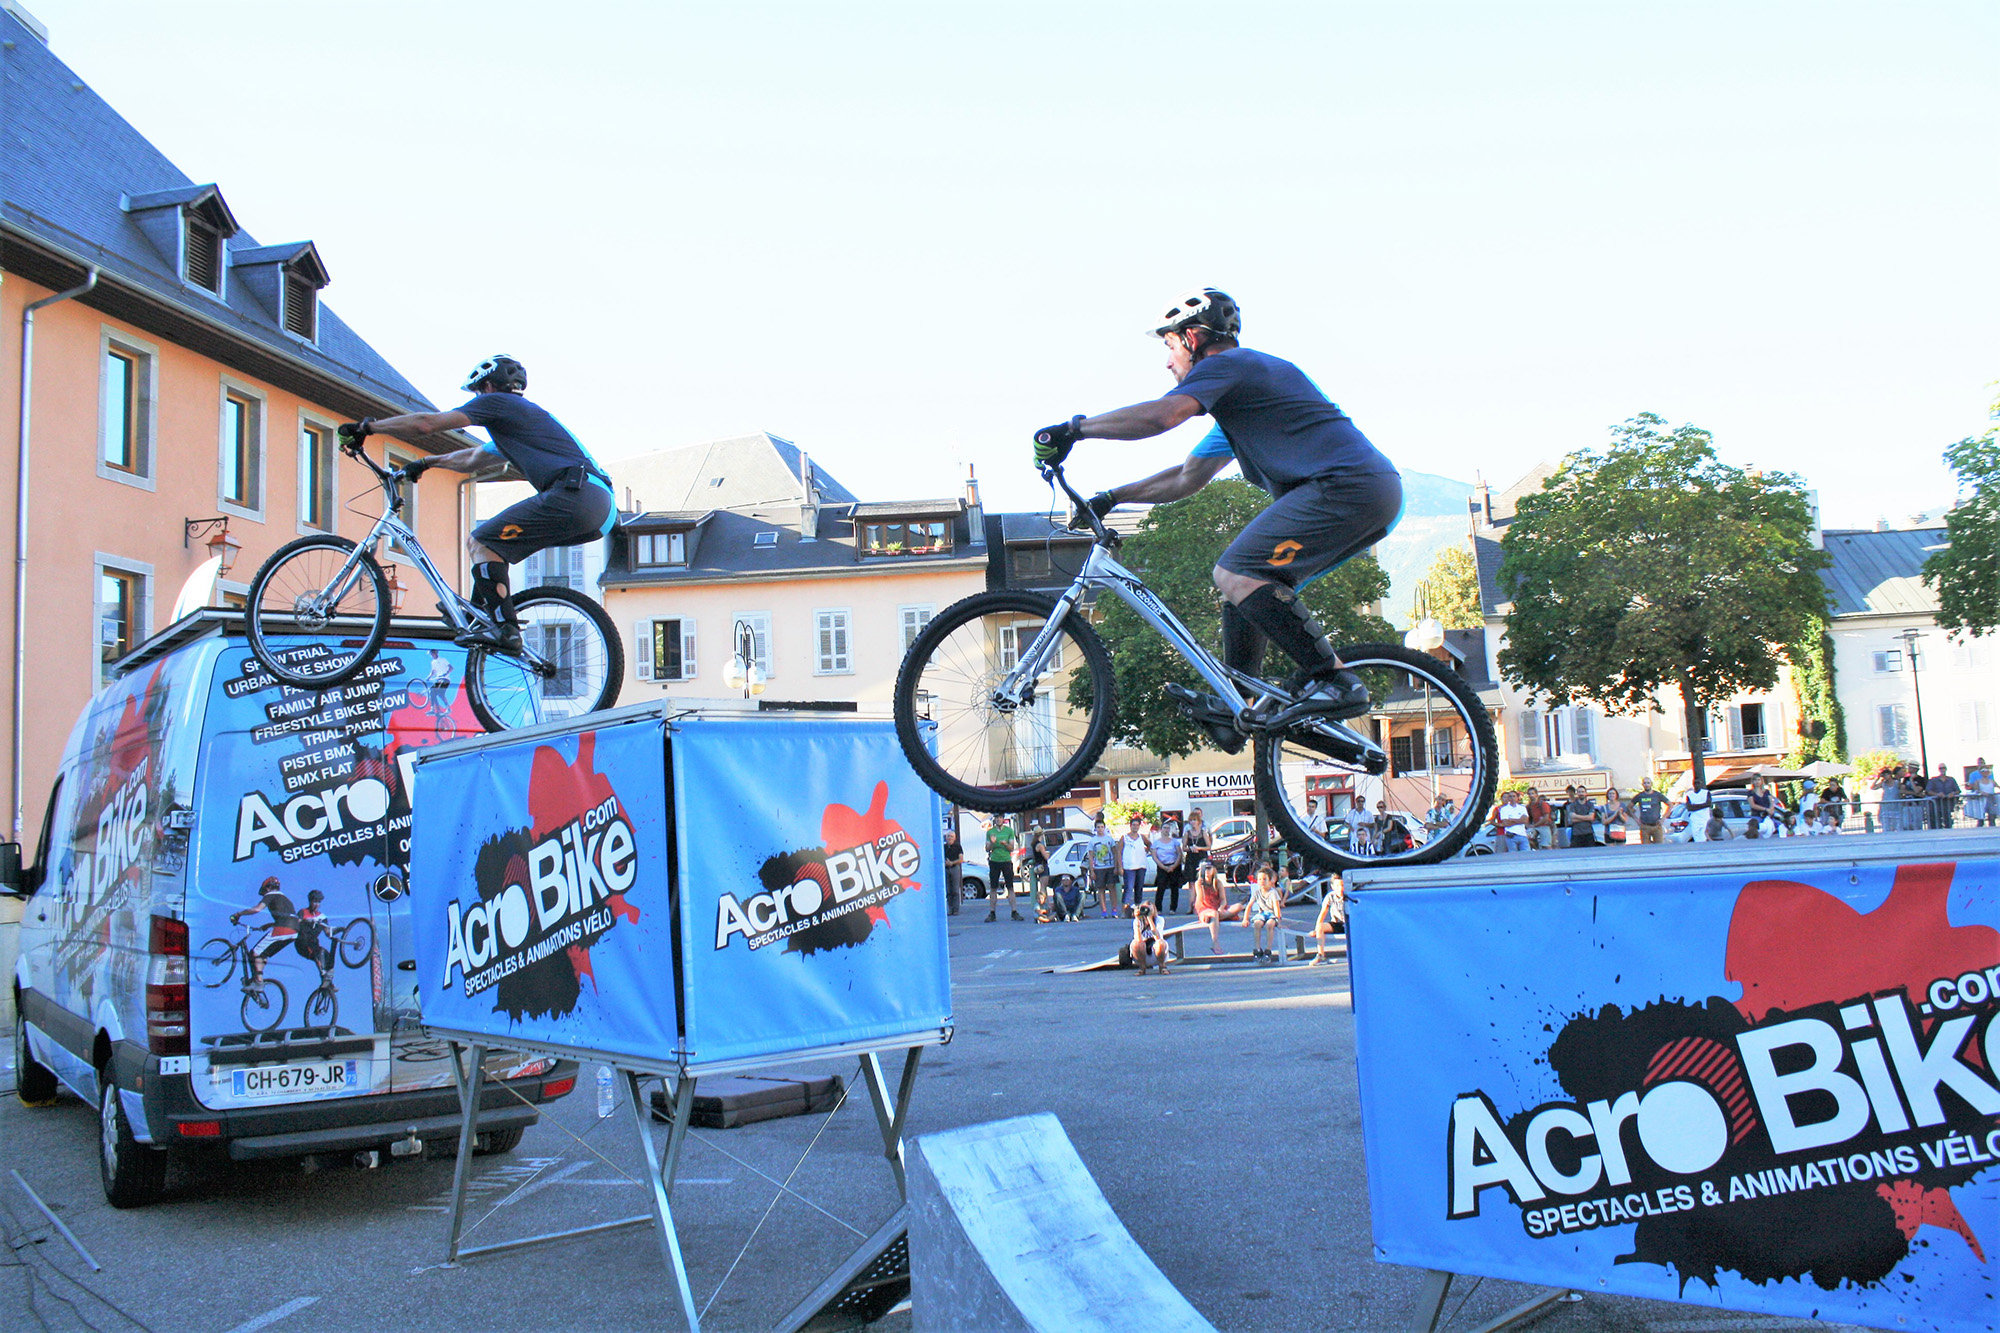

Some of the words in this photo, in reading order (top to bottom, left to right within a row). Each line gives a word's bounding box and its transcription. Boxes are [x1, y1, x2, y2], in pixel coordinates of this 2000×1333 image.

[289, 646, 329, 662] TRIAL
[314, 655, 355, 671] SHOW
[365, 661, 401, 676] PARK
[255, 711, 333, 741] FREESTYLE
[335, 702, 366, 720] BIKE
[367, 693, 406, 711] SHOW
[269, 697, 316, 719] FAMILY
[320, 692, 342, 706] AIR
[344, 682, 381, 700] JUMP
[303, 728, 343, 746] TRIAL
[345, 718, 381, 736] PARK
[283, 753, 323, 772] PISTE
[324, 743, 356, 760] BMX
[287, 771, 320, 789] BMX
[321, 762, 353, 782] FLAT
[1127, 777, 1200, 791] COIFFURE
[1206, 774, 1257, 787] HOMM
[1220, 789, 1247, 797] STUDIO
[236, 778, 390, 860] Acro
[582, 795, 619, 833] .com
[93, 783, 148, 906] Bike
[283, 827, 374, 862] SPECTACLES
[376, 825, 387, 836] &
[875, 830, 905, 850] .com
[528, 819, 636, 932] Bike
[825, 841, 920, 903] Bike
[716, 878, 822, 950] Acro
[749, 919, 811, 950] SPECTACLES
[811, 916, 820, 926] &
[821, 895, 876, 924] ANIMATIONS
[877, 884, 900, 901] VÉLO
[444, 884, 529, 987] Acro
[464, 954, 518, 996] SPECTACLES
[518, 953, 526, 967] &
[526, 921, 582, 966] ANIMATIONS
[582, 907, 612, 936] VÉLO
[246, 1065, 345, 1090] CH-679-JR
[346, 1073, 357, 1083] 73
[1453, 1080, 1728, 1214] Acro
[1526, 1184, 1696, 1236] SPECTACLES
[1701, 1180, 1724, 1207] &
[1728, 1144, 1921, 1203] ANIMATIONS
